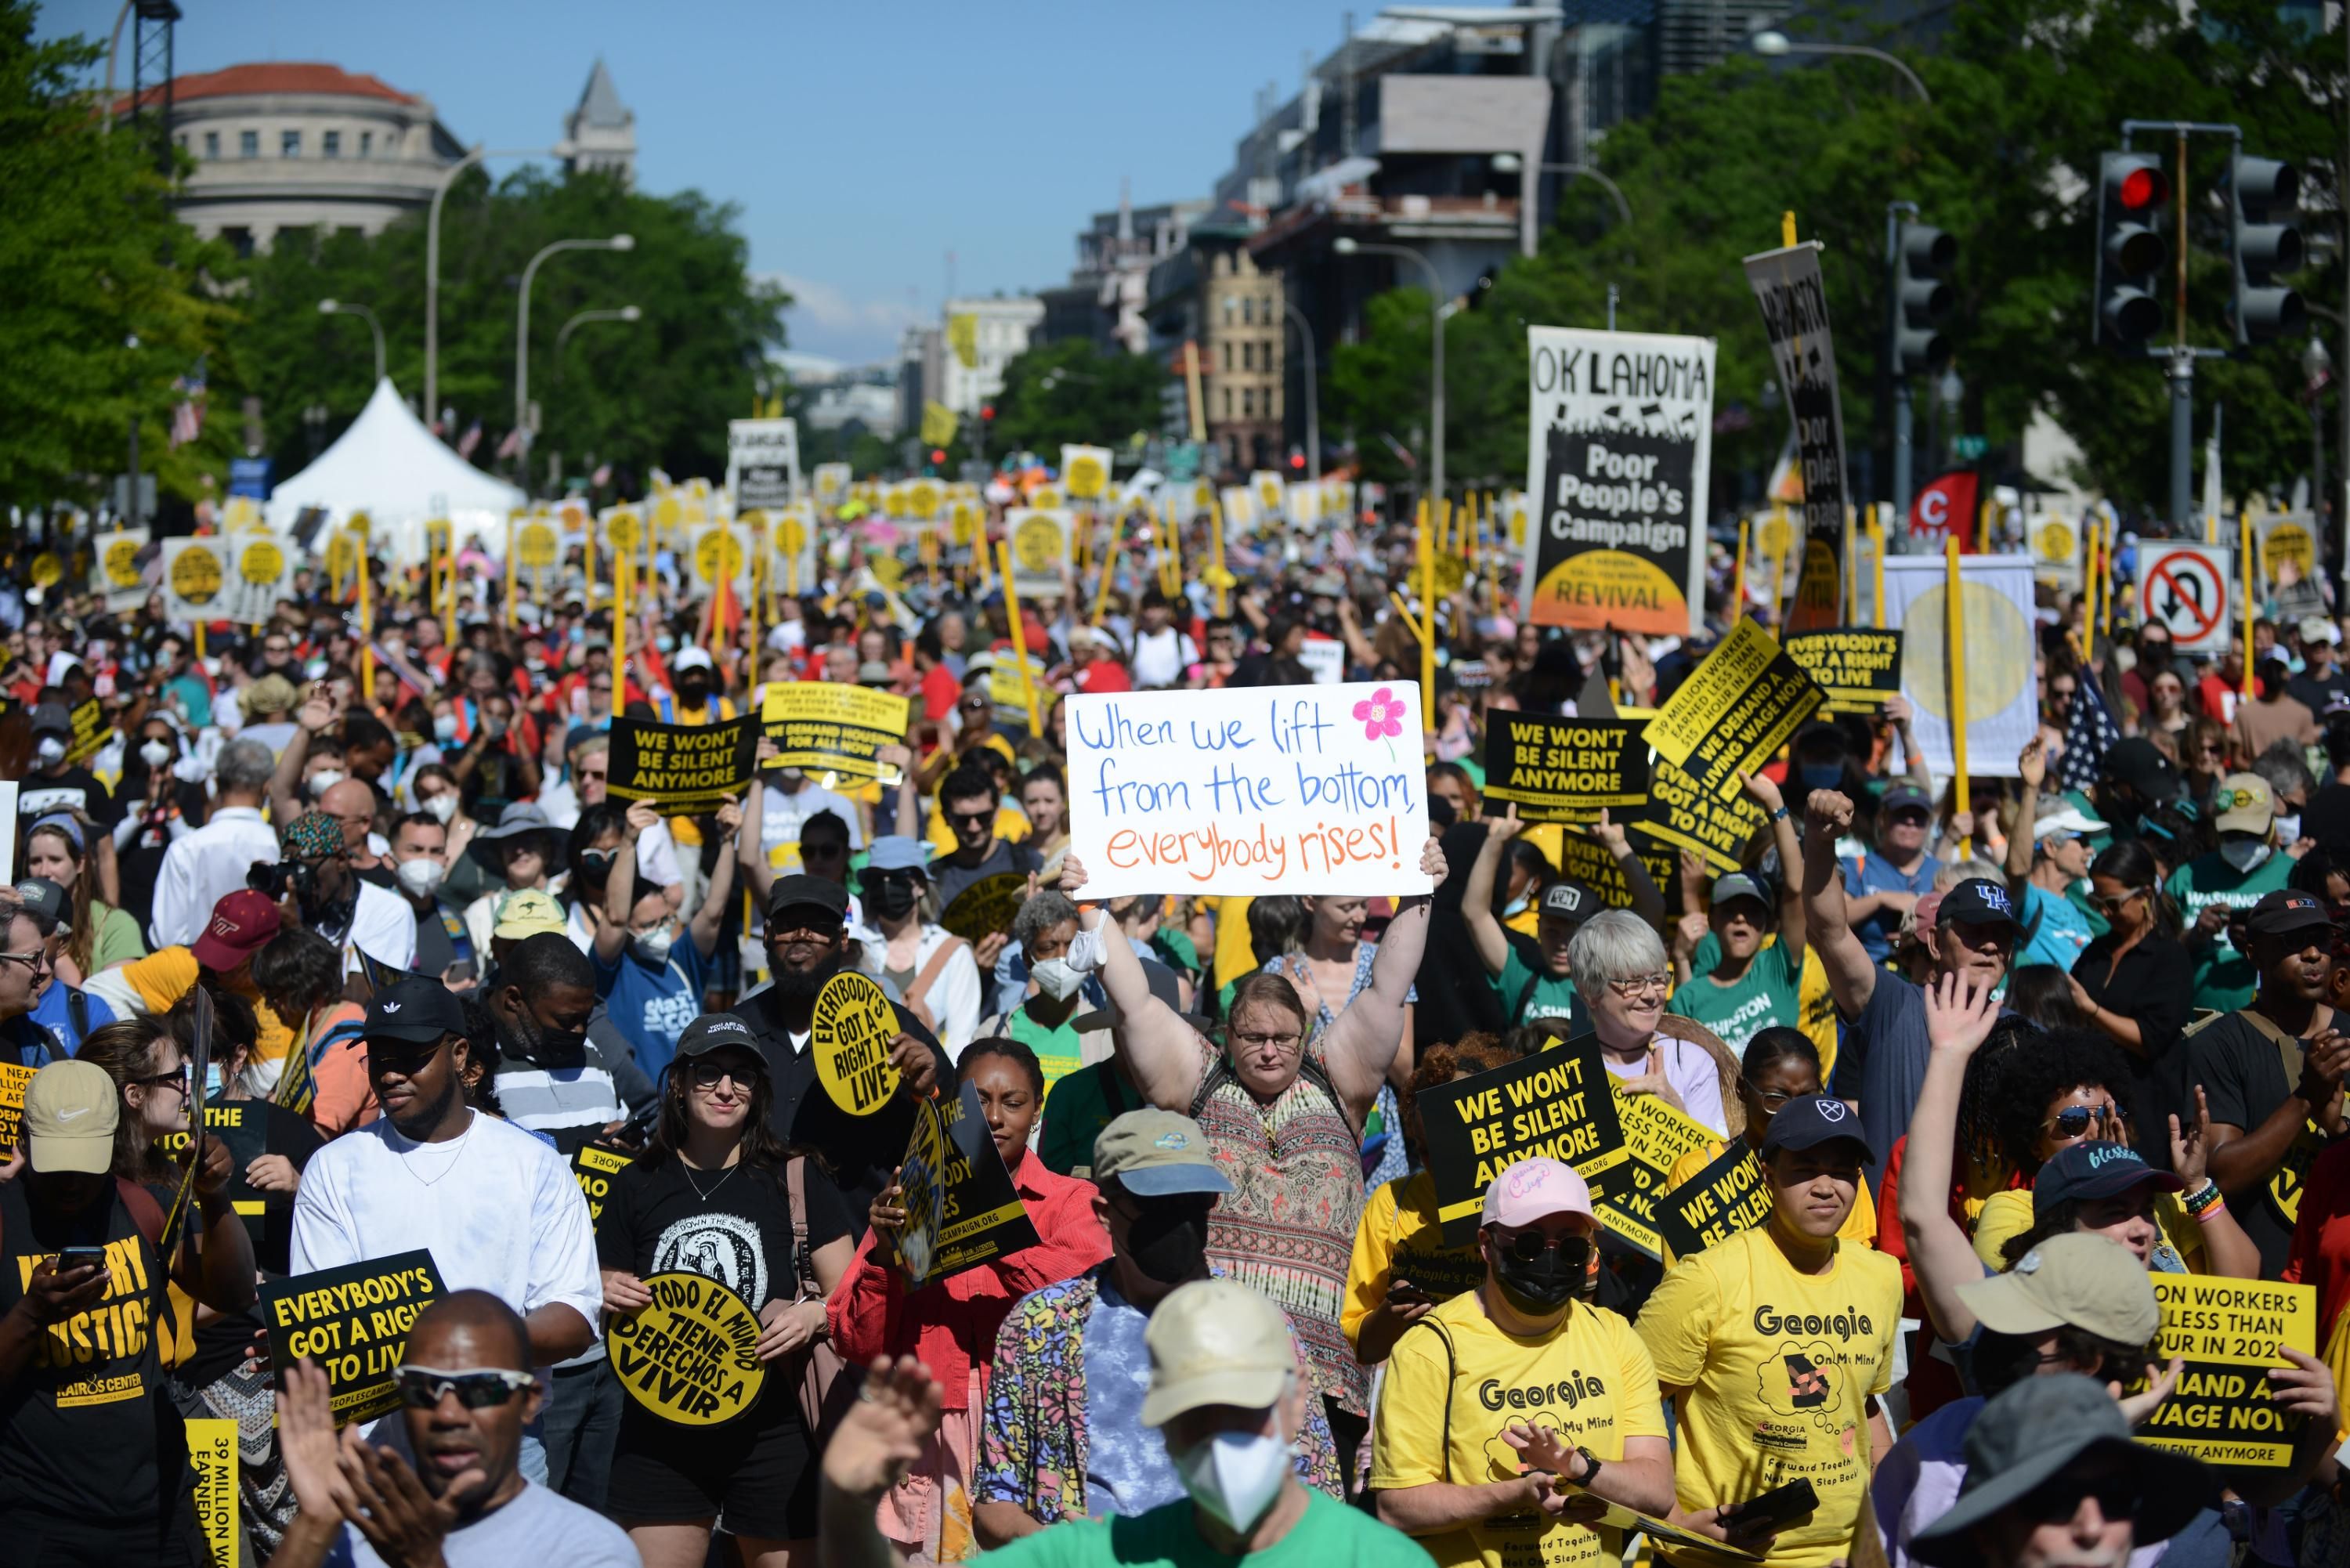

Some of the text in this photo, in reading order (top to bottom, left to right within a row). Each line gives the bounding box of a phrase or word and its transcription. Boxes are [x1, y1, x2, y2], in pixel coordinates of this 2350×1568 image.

[1535, 345, 1707, 400] OKLAHOMA
[1587, 443, 1658, 481] Poor
[1557, 473, 1684, 518] People's
[1550, 510, 1686, 553] Campaign
[1556, 580, 1664, 611] REVIVAL
[1786, 633, 1896, 654] EVERYBODY'S
[1827, 651, 1841, 667] A
[1844, 652, 1893, 670] RIGHT
[1656, 627, 1752, 735] 39 MILLION WORKERS
[1671, 644, 1755, 739] EARNED LESS THAN
[1810, 667, 1872, 686] TO LIVE
[1681, 653, 1766, 748] $15 HOUR IN 2021
[765, 724, 784, 739] WE
[786, 723, 841, 738] DEMAND
[1076, 699, 1335, 753] When we lift
[1698, 672, 1784, 762] WE DEMAND A
[1701, 671, 1806, 790] LIVING WAGE NOW
[634, 726, 741, 750] WE WON'T
[786, 735, 874, 757] FOR ALL NOW
[1509, 721, 1627, 748] WE WON'T
[638, 747, 736, 770] BE SILENT
[1515, 745, 1620, 770] BE SILENT
[631, 765, 736, 789] ANYMORE
[1092, 758, 1415, 817] from the bottom,
[1509, 767, 1622, 791] ANYMORE
[1652, 781, 1756, 841] GOT A RIGH
[1669, 807, 1735, 852] TO LIVE
[1106, 815, 1401, 881] everybody rises!
[1569, 859, 1612, 885] GOT A
[1608, 887, 1633, 907] LIV
[1976, 885, 2012, 918] UK
[815, 977, 886, 1043] EVERYBODY'S
[836, 1008, 877, 1046] GOT A
[833, 1029, 893, 1081] RIGHT TO
[851, 1060, 891, 1111] LIVE
[1455, 1087, 1503, 1125] WE
[1505, 1057, 1583, 1108] WON'T
[204, 1108, 242, 1127] THE
[941, 1097, 966, 1126] THE
[1470, 1121, 1506, 1155] BE
[1513, 1091, 1586, 1141] SILENT
[1618, 1107, 1652, 1135] LESS
[592, 1154, 624, 1168] MORE
[1474, 1122, 1600, 1189] ANYMORE
[1631, 1136, 1672, 1166] IN 20
[1679, 1148, 1762, 1230] WE WON'T
[663, 1229, 678, 1244] CAST
[680, 1219, 707, 1231] DOWN
[729, 1222, 758, 1239] MIGHTY
[1604, 1212, 1656, 1246] ANYMORE
[1701, 1220, 1726, 1248] BE
[1408, 1265, 1460, 1284] People's
[273, 1267, 433, 1327] EVERYBODY'S
[2195, 1287, 2297, 1313] WORKERS
[649, 1280, 759, 1371] TODO EL MUNDO
[1754, 1305, 1874, 1343] Georgia
[2169, 1310, 2283, 1335] LESS THAN
[289, 1321, 342, 1360] GOT
[350, 1317, 370, 1346] A
[667, 1312, 730, 1365] TIENE
[2157, 1334, 2194, 1353] OUR
[2203, 1336, 2225, 1354] IN
[325, 1341, 406, 1386] TO LIV
[614, 1316, 744, 1405] DERECHOS A
[1814, 1353, 1875, 1366] On Mind
[106, 1372, 142, 1393] CENTER
[619, 1342, 720, 1418] VIVIR
[1479, 1370, 1606, 1411] Georgia
[2250, 1378, 2273, 1400] A
[1563, 1414, 1613, 1435] My Mind
[1762, 1423, 1806, 1433] GEORGIA
[2228, 1407, 2301, 1433] NOW
[215, 1438, 229, 1459] 39
[2200, 1447, 2275, 1461] ANYMORE
[1765, 1473, 1783, 1484] Not
[1817, 1476, 1836, 1487] Step
[1768, 1458, 1817, 1472] Forward
[197, 1451, 210, 1521] EARNED
[215, 1465, 229, 1539] MILLION
[1503, 1554, 1576, 1568] Not One Step
[1504, 1540, 1553, 1552] Forward
